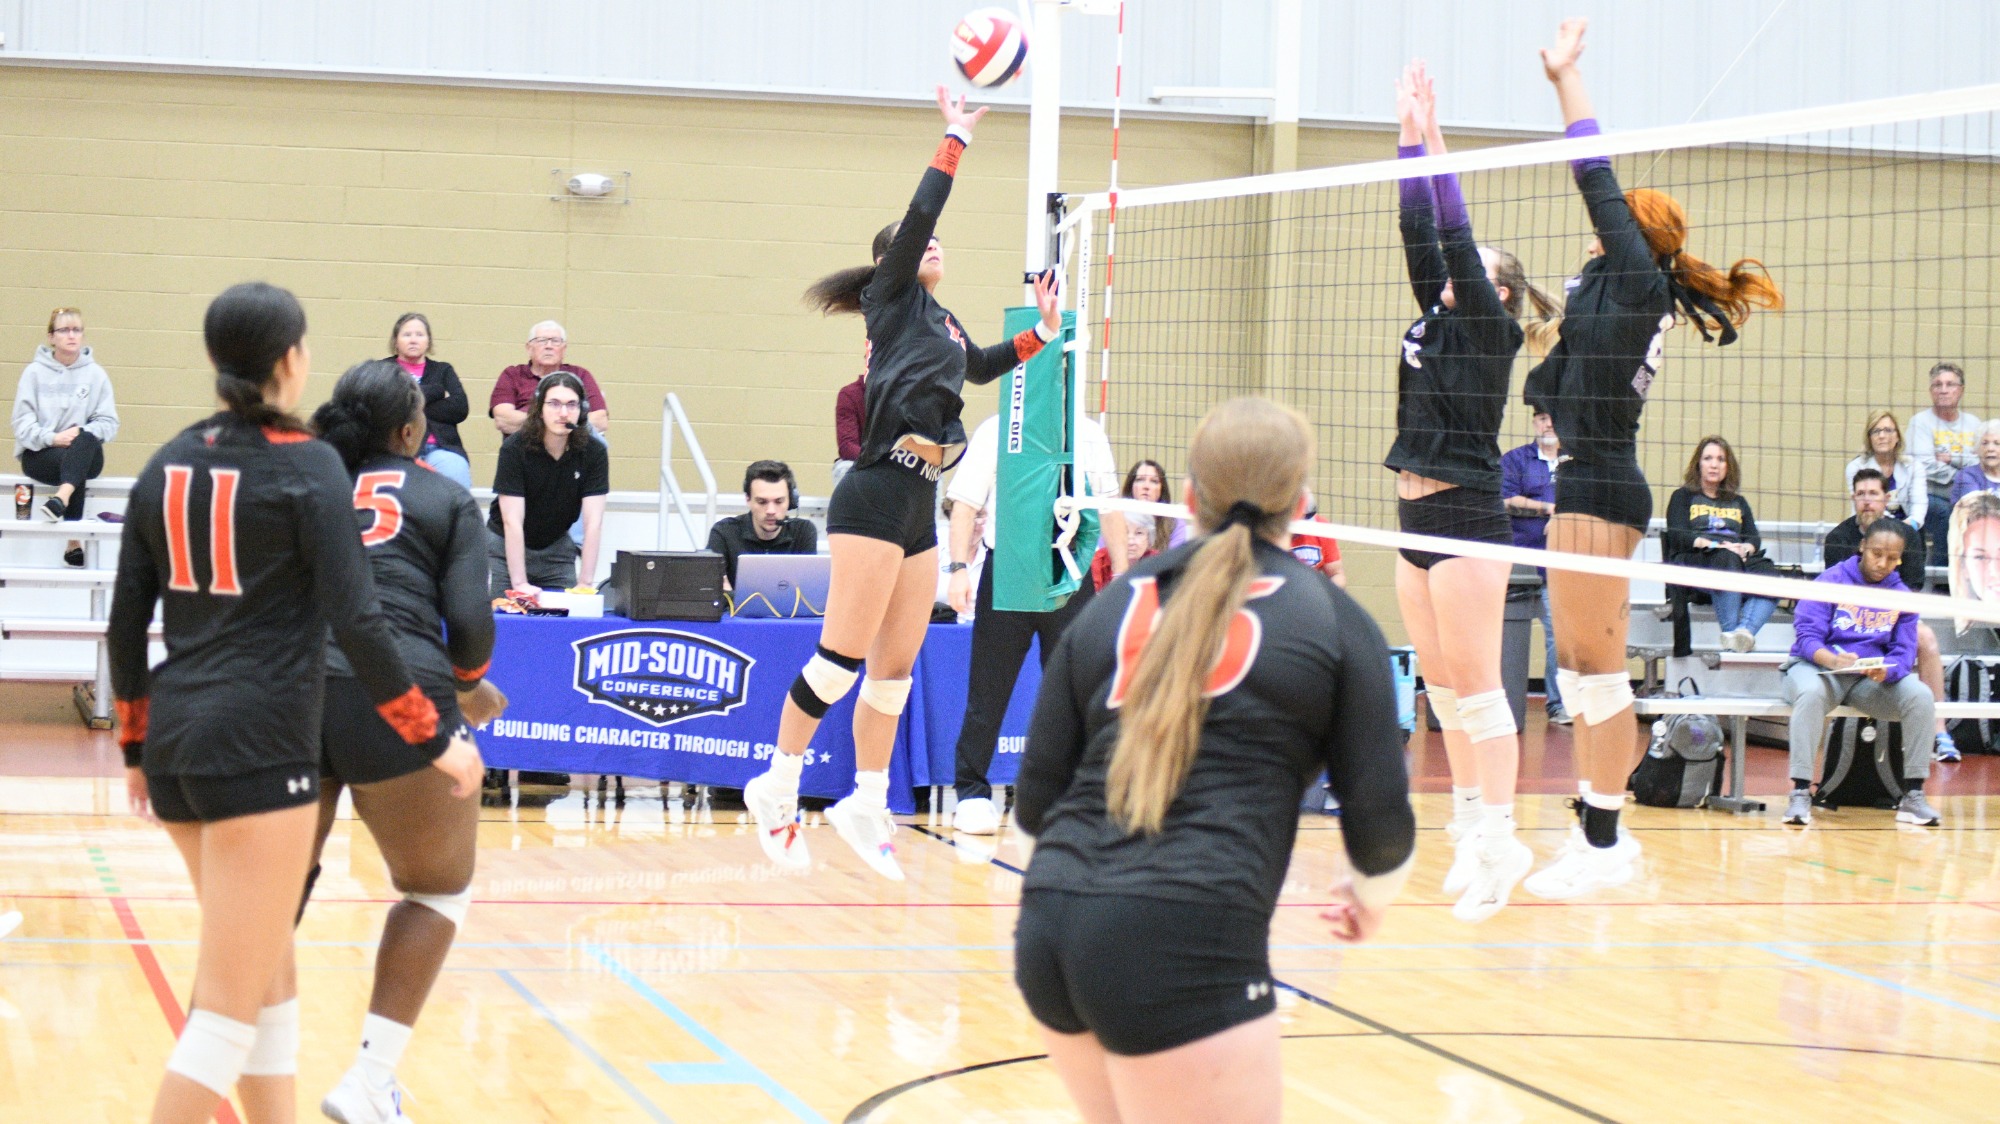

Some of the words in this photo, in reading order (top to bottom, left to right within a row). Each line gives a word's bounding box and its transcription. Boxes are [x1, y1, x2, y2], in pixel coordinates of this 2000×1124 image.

[889, 447, 919, 469] RO
[919, 461, 942, 481] NIK
[163, 465, 243, 596] 11
[353, 470, 406, 547] 5
[587, 640, 738, 694] MID-SOUTH
[601, 679, 720, 702] CONFERENCE
[493, 719, 571, 742] BUILDING
[574, 725, 670, 750] CHARACTER
[674, 733, 749, 759] THROUGH
[753, 742, 816, 766] SPS
